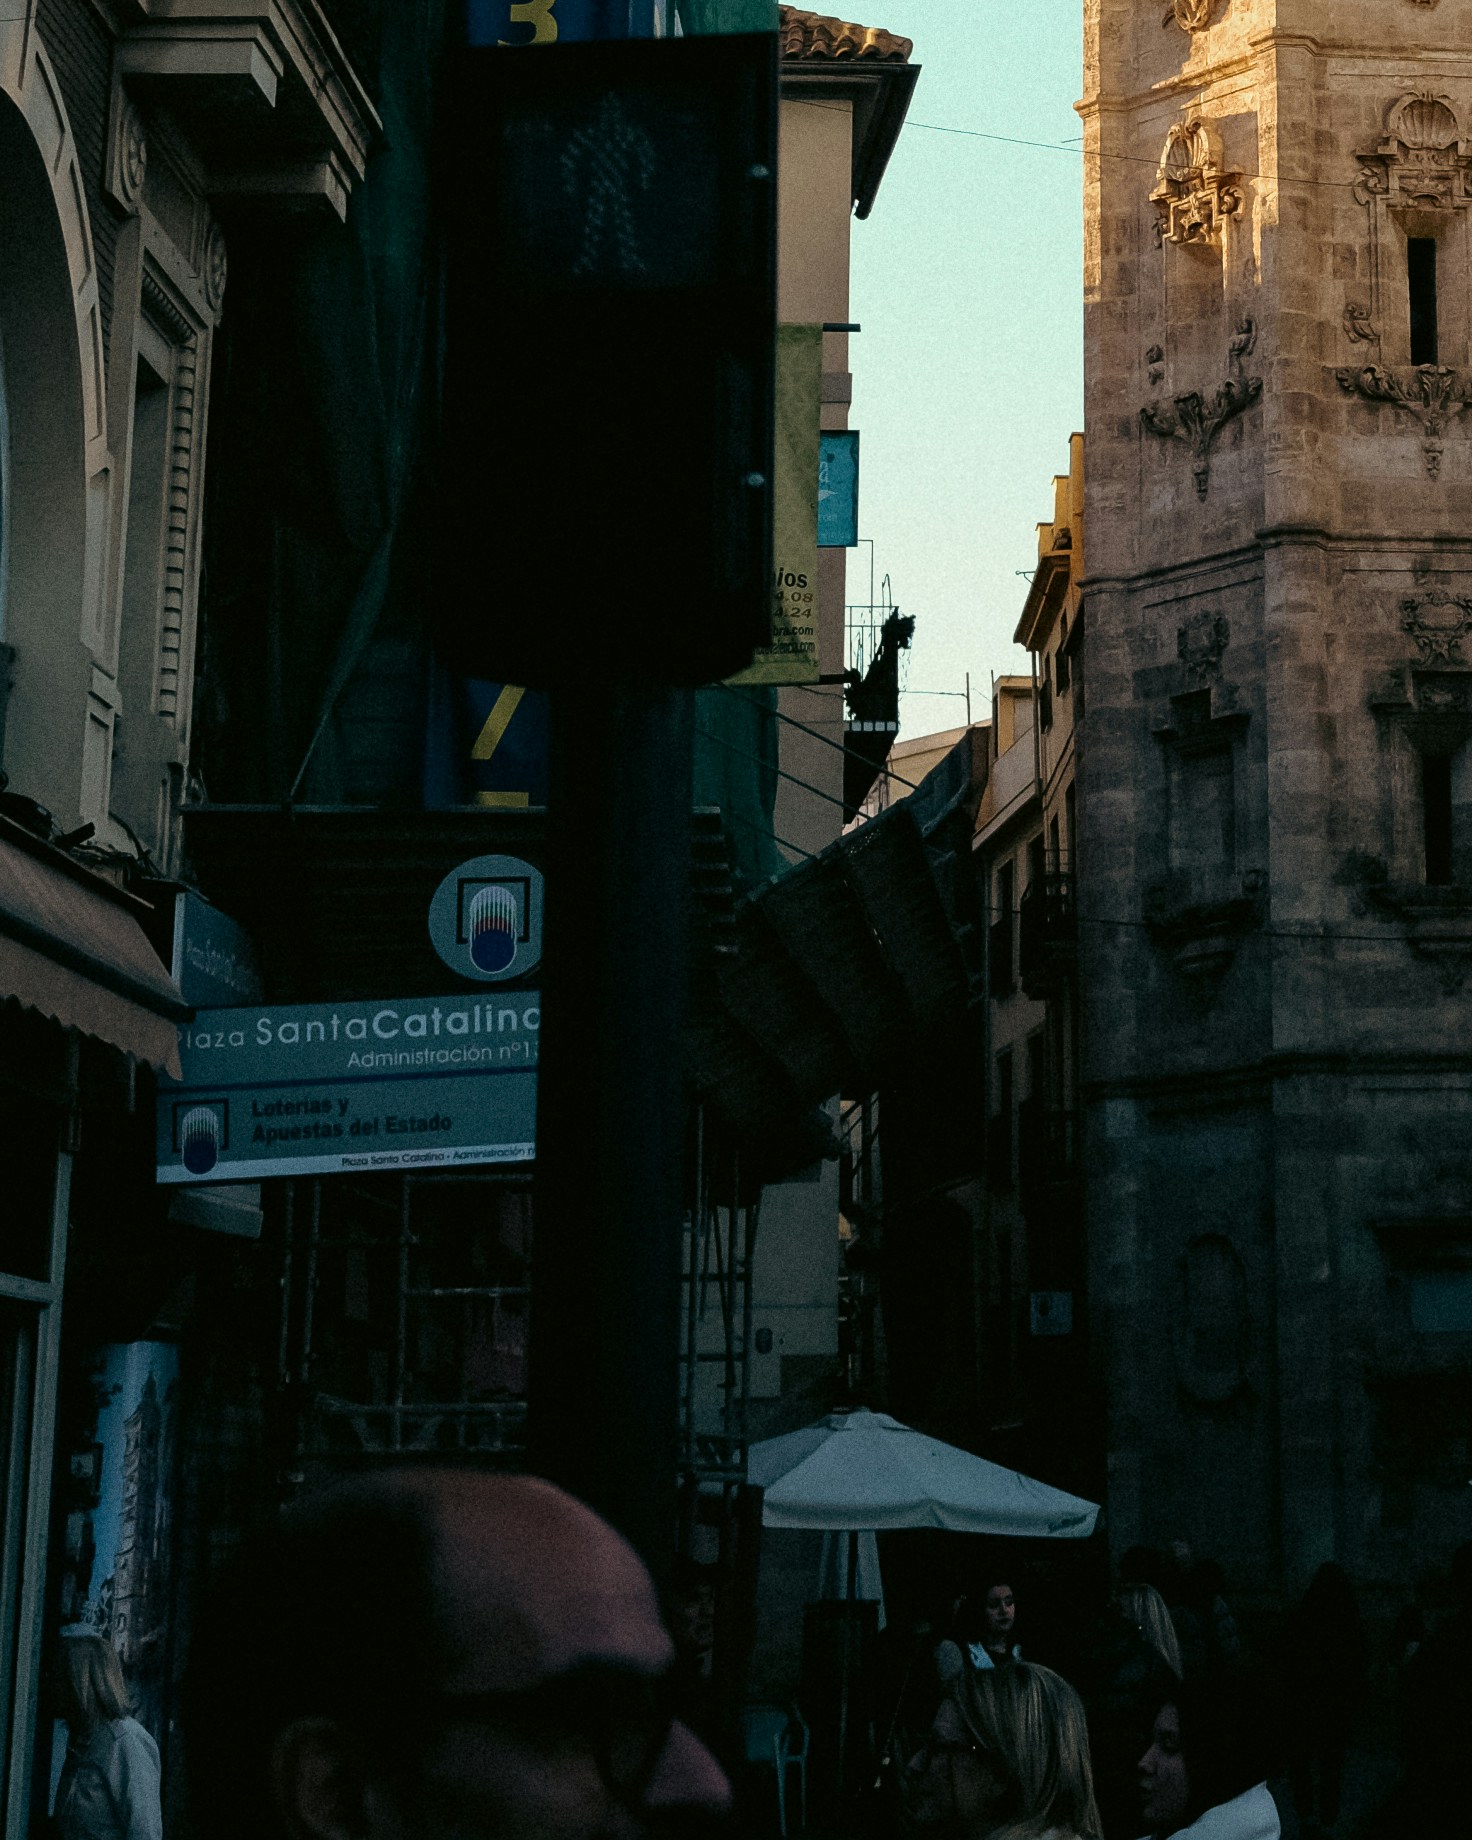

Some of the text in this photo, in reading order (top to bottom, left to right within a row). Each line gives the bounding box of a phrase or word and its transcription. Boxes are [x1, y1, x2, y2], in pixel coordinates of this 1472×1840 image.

[777, 567, 808, 589] ios
[178, 1029, 244, 1050] laza
[338, 1097, 349, 1117] y
[252, 1113, 452, 1146] Apuestas del Estado
[371, 1153, 399, 1165] Santa
[402, 1150, 445, 1164] Catalina
